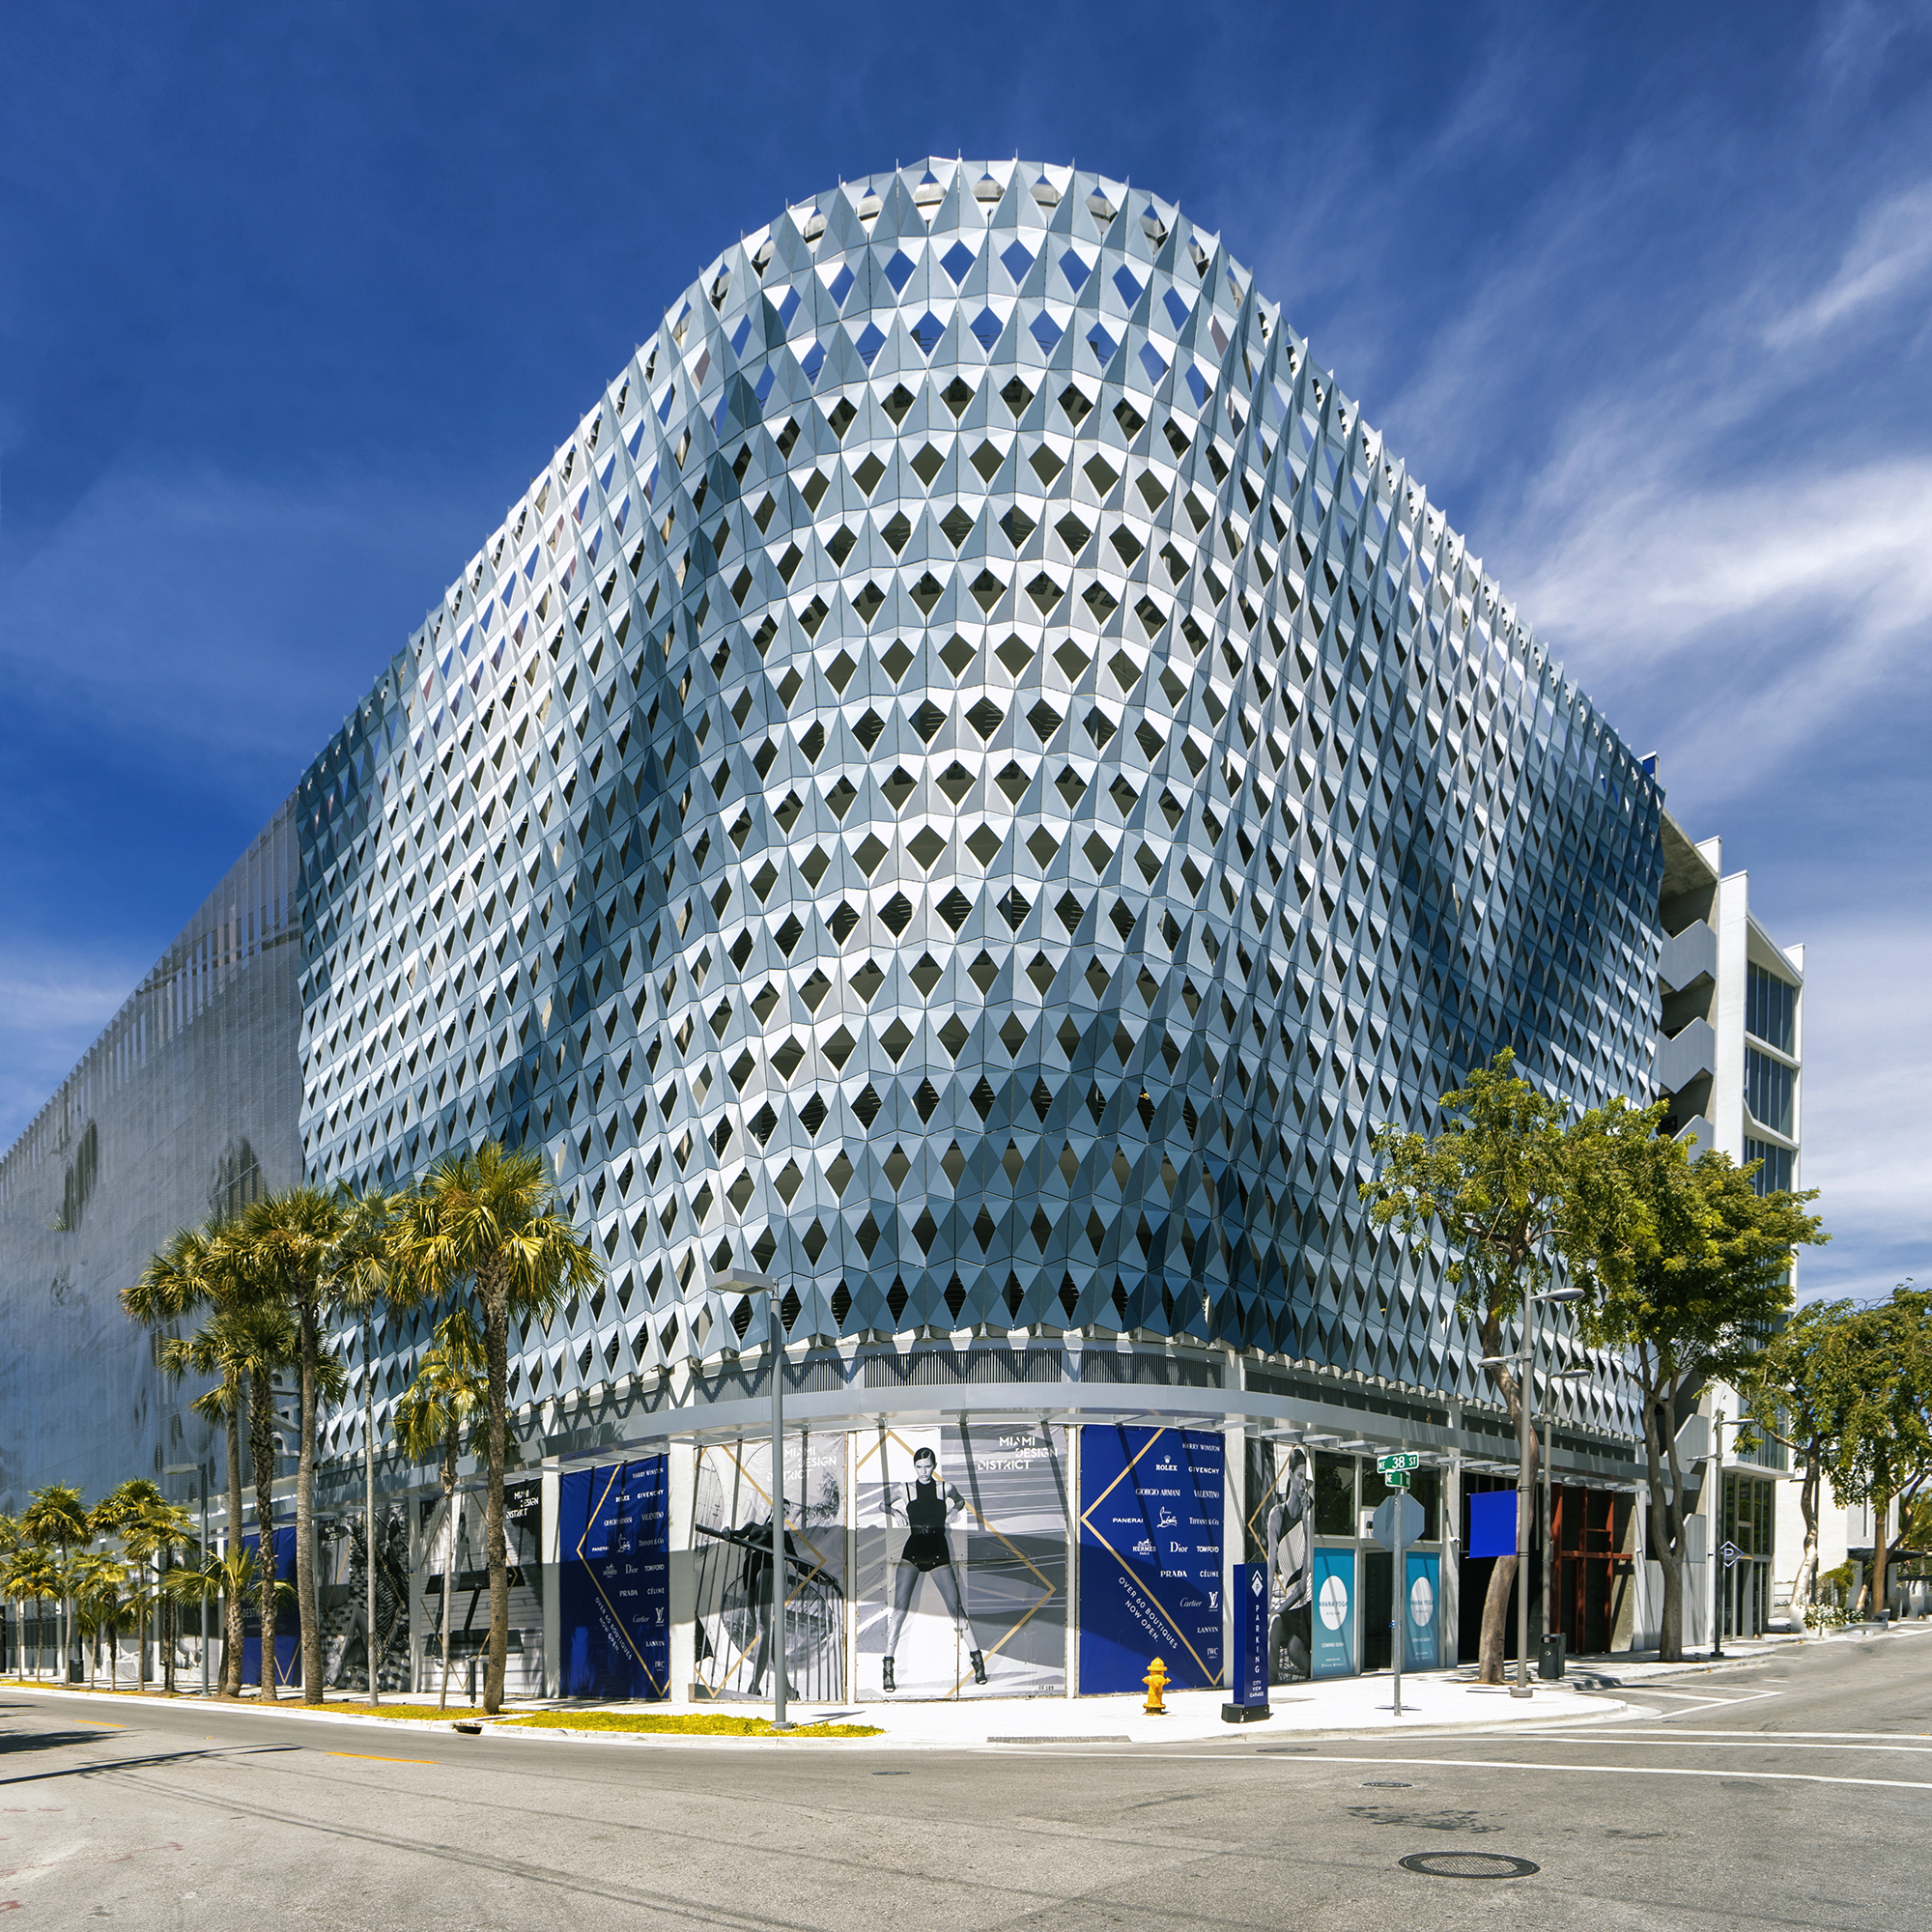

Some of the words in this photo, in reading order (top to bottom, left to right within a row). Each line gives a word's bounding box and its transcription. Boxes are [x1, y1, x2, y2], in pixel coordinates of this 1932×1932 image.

[999, 1435, 1036, 1447] MIAMI
[784, 1446, 816, 1458] MIAMI
[1014, 1447, 1058, 1459] DESIGN
[797, 1456, 837, 1467] DESIGN
[977, 1459, 1033, 1470] DISTRICT
[1392, 1456, 1405, 1469] 38
[1409, 1457, 1416, 1465] ST
[766, 1469, 813, 1482] DTRICT
[1194, 1490, 1219, 1498] VALENTINO
[1170, 1542, 1188, 1552] Dior
[625, 1564, 638, 1574] Dior
[1179, 1597, 1203, 1607] Cartier
[633, 1614, 650, 1623] Cartier
[1119, 1577, 1137, 1599] OVER
[1136, 1598, 1146, 1608] 60
[1145, 1607, 1179, 1649] BOUTIQUES
[599, 1617, 610, 1634] NOW
[1124, 1600, 1142, 1618] NOW
[1141, 1619, 1159, 1642] OPEN.
[595, 1597, 607, 1614] OVER
[605, 1614, 611, 1624] 60
[610, 1623, 633, 1661] BOUTIQUES
[1208, 1647, 1218, 1656] IWC
